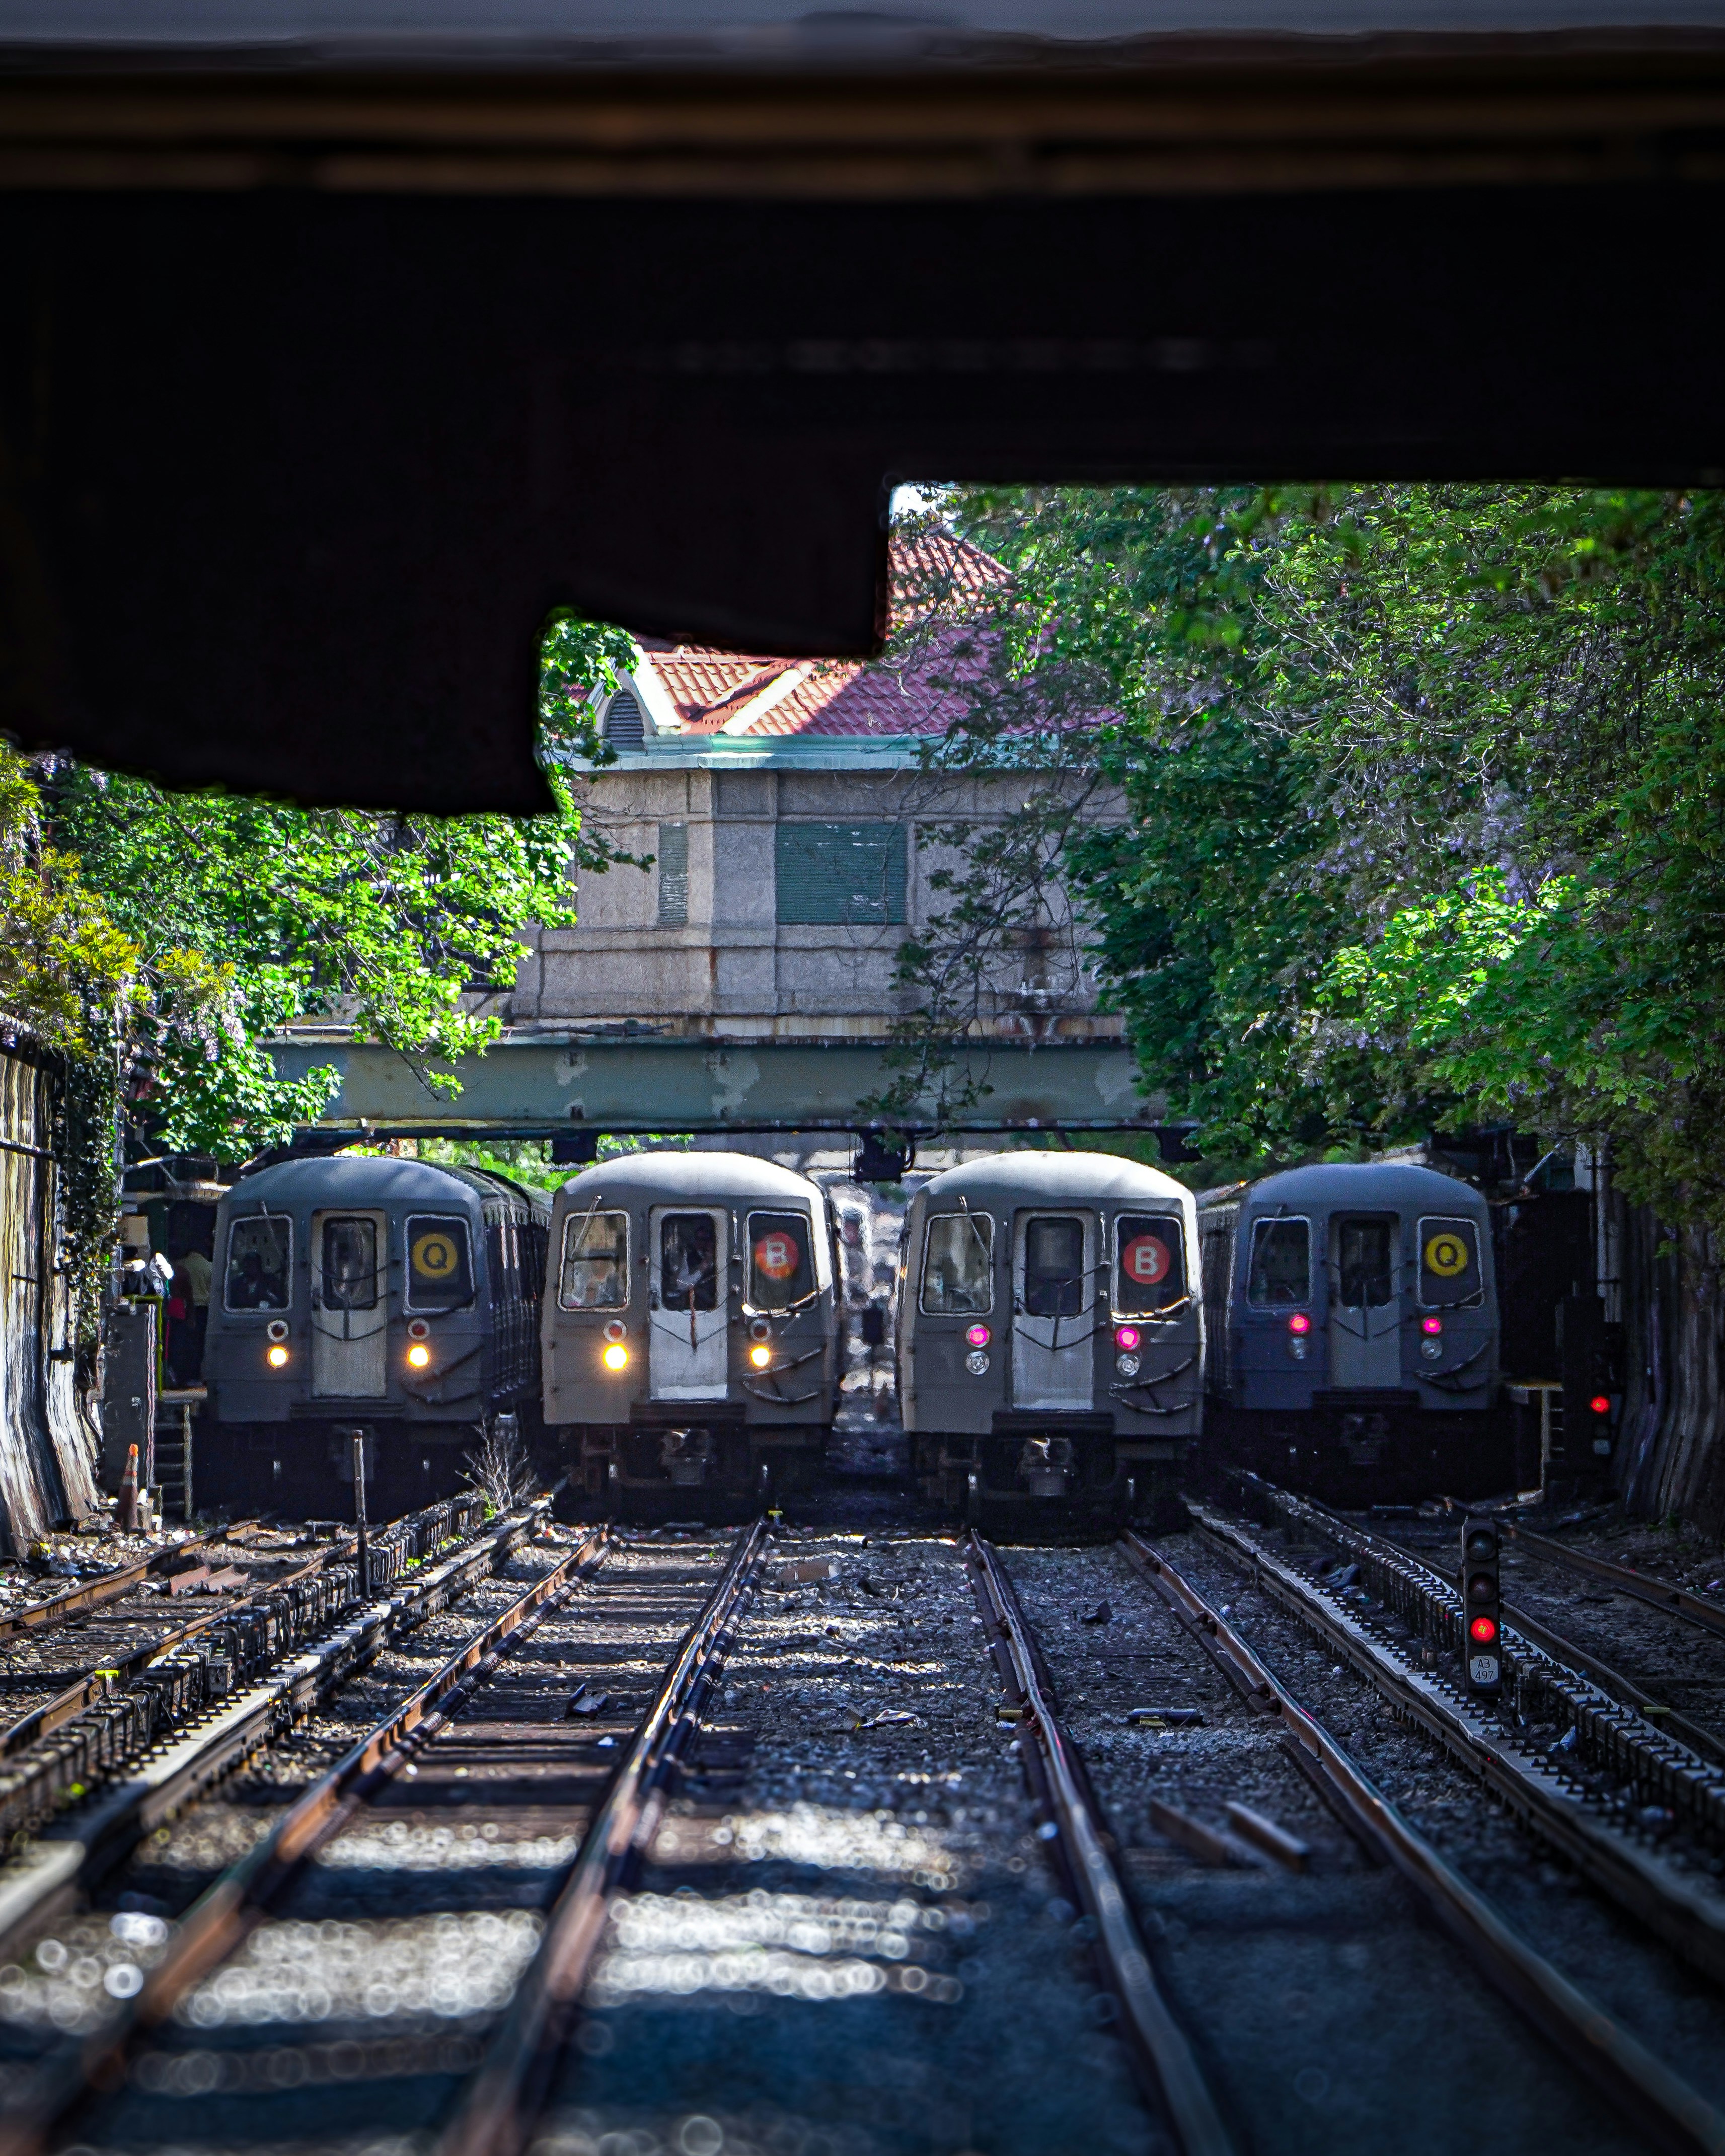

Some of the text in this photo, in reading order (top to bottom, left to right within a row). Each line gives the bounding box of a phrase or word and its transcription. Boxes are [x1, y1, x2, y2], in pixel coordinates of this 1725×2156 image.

[423, 1242, 448, 1269] Q
[766, 1241, 788, 1268] B
[1135, 1246, 1159, 1275] B
[1436, 1242, 1458, 1267] Q
[1475, 1670, 1494, 1680] 497
[1477, 1658, 1490, 1669] A3
